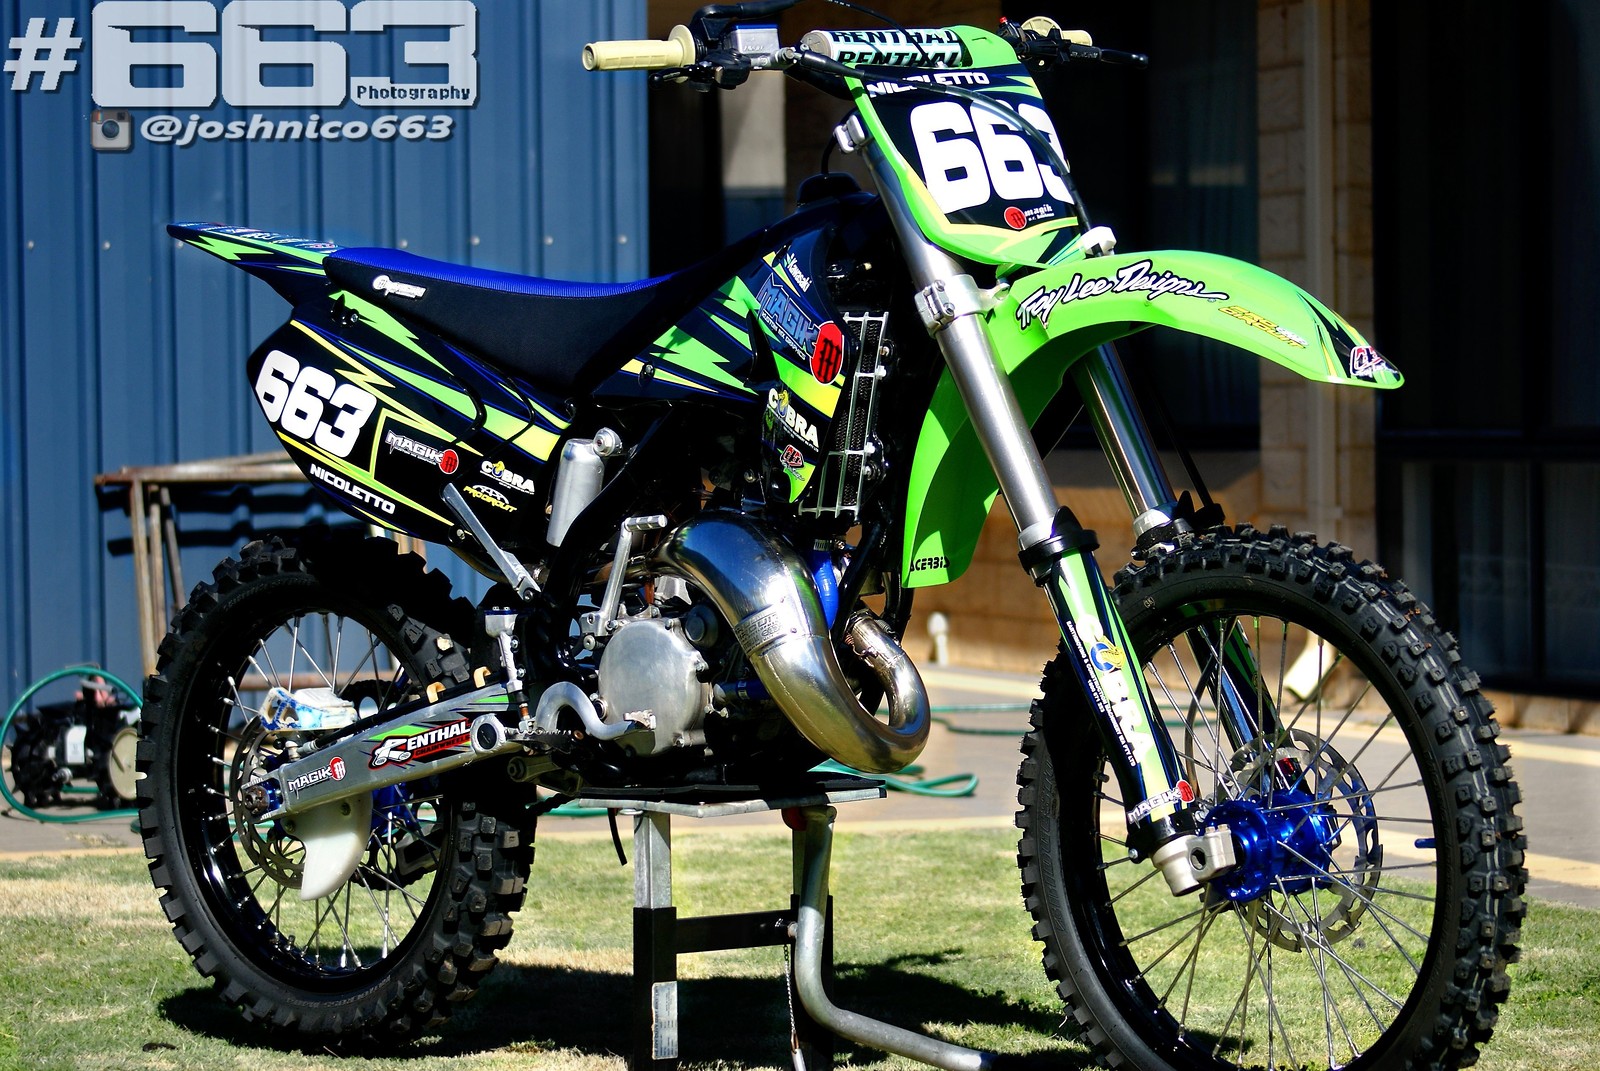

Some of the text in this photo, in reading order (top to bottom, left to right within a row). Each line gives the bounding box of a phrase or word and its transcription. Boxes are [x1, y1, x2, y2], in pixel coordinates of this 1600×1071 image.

[910, 99, 1075, 214] 663
[786, 258, 812, 292] Kawasaki
[1016, 259, 1230, 329] Troy Lee Designs
[756, 272, 821, 359] MAGIK
[254, 350, 377, 458] 663
[768, 388, 820, 449] COBRA
[385, 430, 445, 463] MAGIK
[310, 464, 395, 514] NICOLETTO
[480, 460, 536, 493] COBRA
[372, 720, 471, 768] RENTHAL
[288, 765, 334, 797] MAGIK
